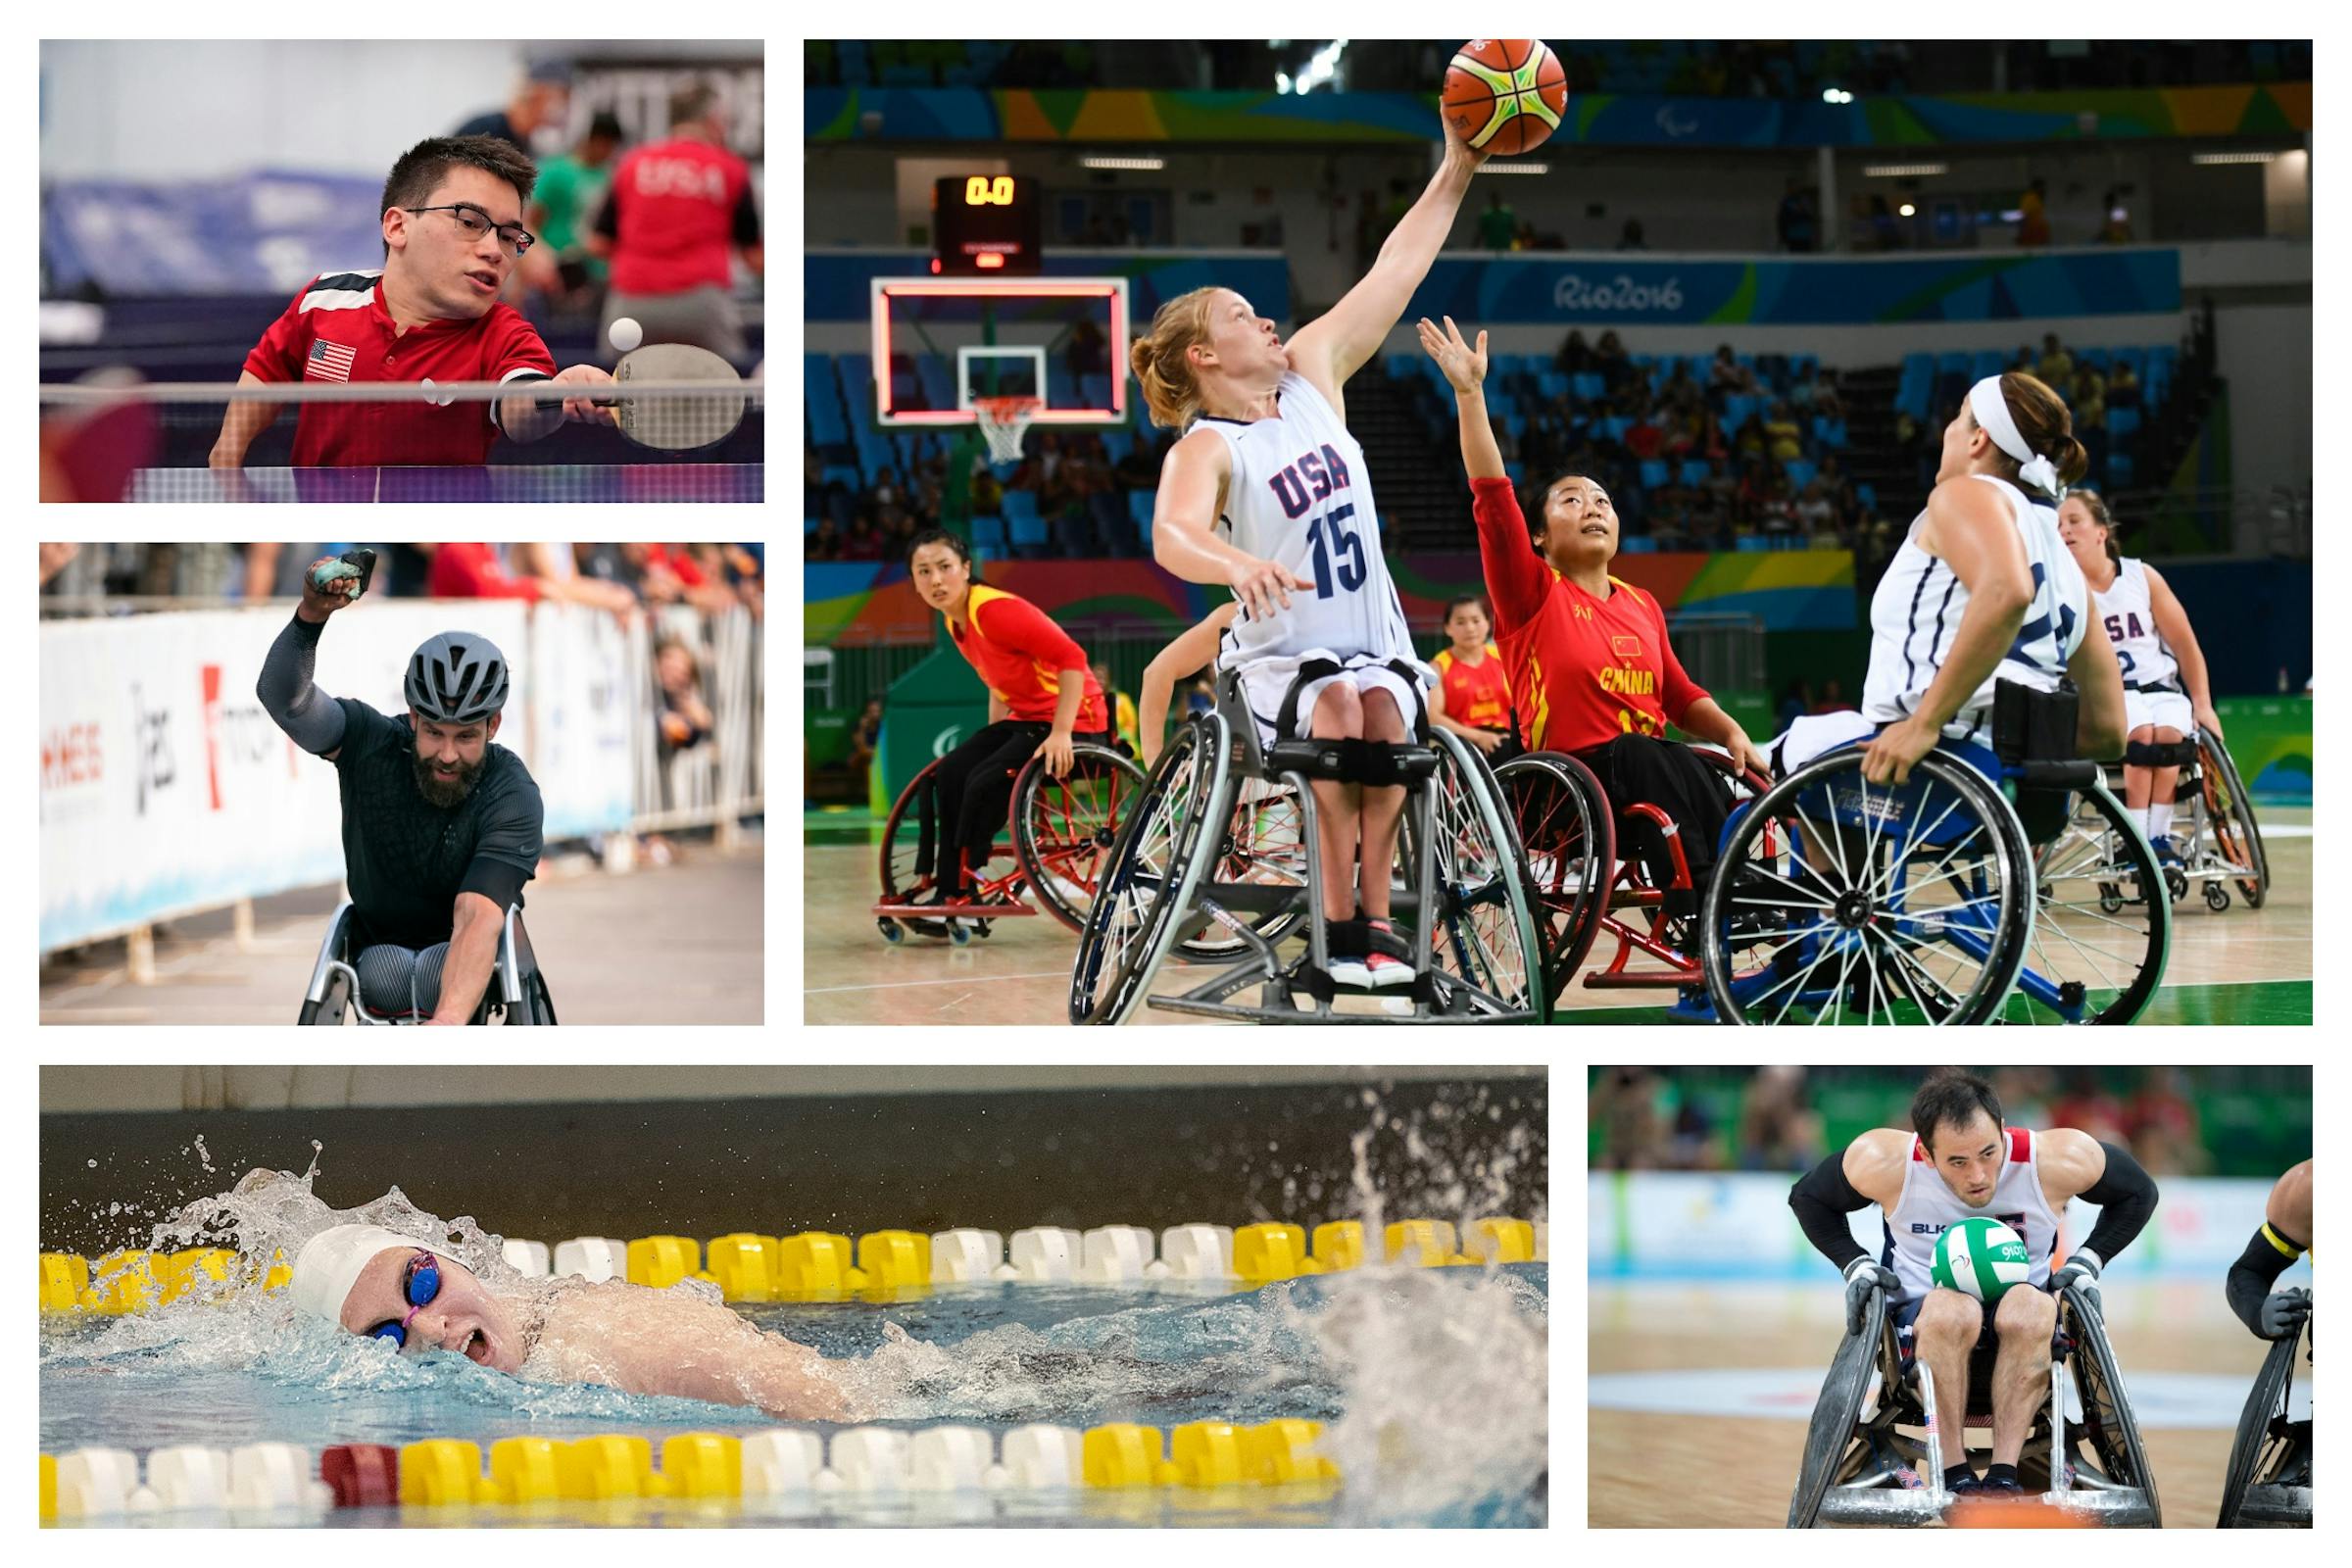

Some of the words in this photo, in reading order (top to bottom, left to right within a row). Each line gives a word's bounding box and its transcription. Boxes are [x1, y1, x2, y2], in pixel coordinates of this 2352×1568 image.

[1553, 274, 1685, 311] Rio2016
[1268, 444, 1350, 519] USA
[1306, 503, 1367, 600] 15
[2103, 612, 2145, 643] SA
[1598, 666, 1654, 695] CHINA
[1911, 1223, 1946, 1234] BLK
